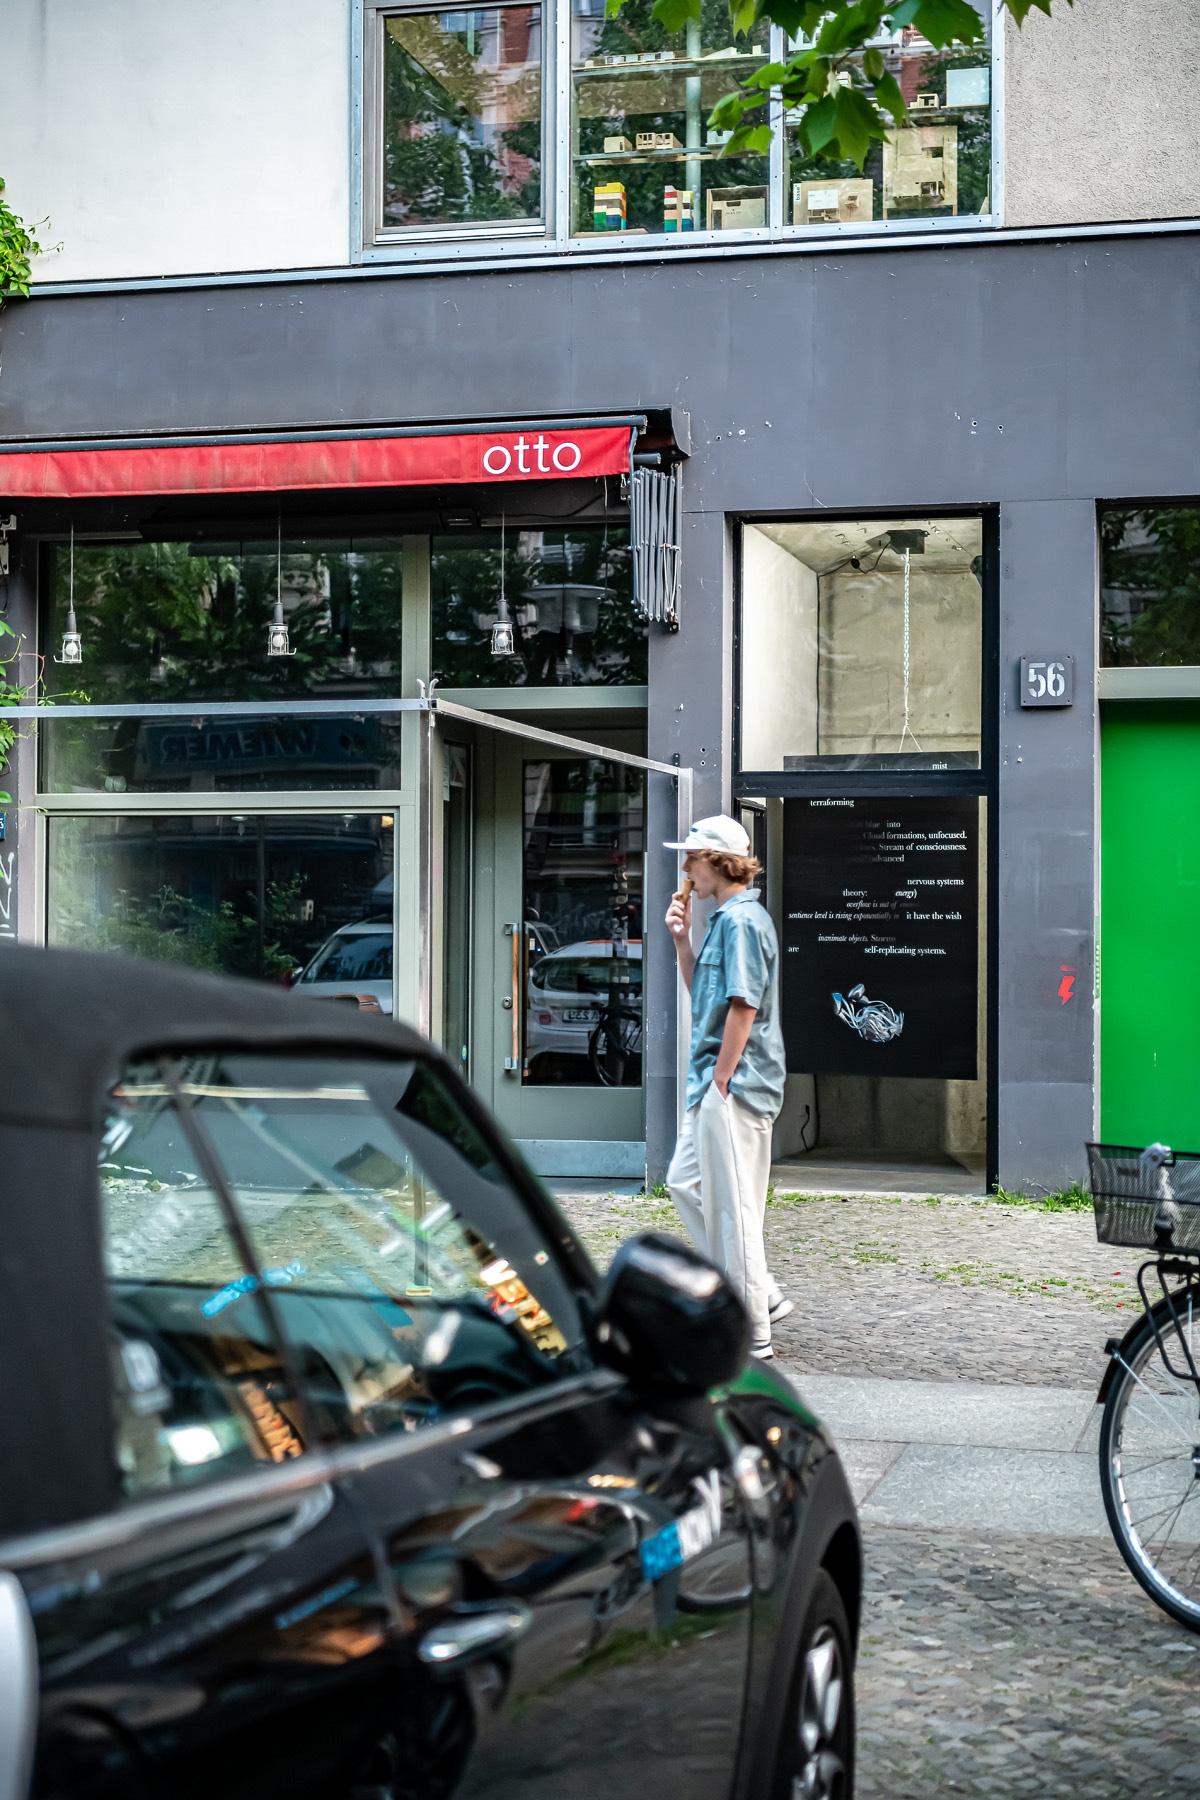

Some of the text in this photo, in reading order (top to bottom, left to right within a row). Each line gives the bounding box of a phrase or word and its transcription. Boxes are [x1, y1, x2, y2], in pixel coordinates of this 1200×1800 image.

[483, 435, 581, 475] otto
[1028, 662, 1065, 697] 56
[932, 762, 948, 770] mist
[811, 798, 854, 808] terraforming
[863, 832, 885, 840] Cloud
[886, 831, 927, 841] formations,
[929, 831, 967, 839] unfocused.
[879, 843, 905, 851] Stream
[906, 843, 914, 851] of
[916, 843, 967, 851] consciousness.
[937, 878, 965, 886] systems
[843, 889, 868, 897] theory:
[873, 900, 878, 908] is
[835, 912, 852, 921] rising
[853, 912, 892, 921] exponentially
[906, 912, 912, 920] it
[913, 912, 930, 920] have
[932, 912, 944, 920] the
[945, 912, 962, 920] wish
[818, 934, 847, 942] inanimate
[865, 946, 916, 956] self-replicating
[917, 947, 946, 955] systems.
